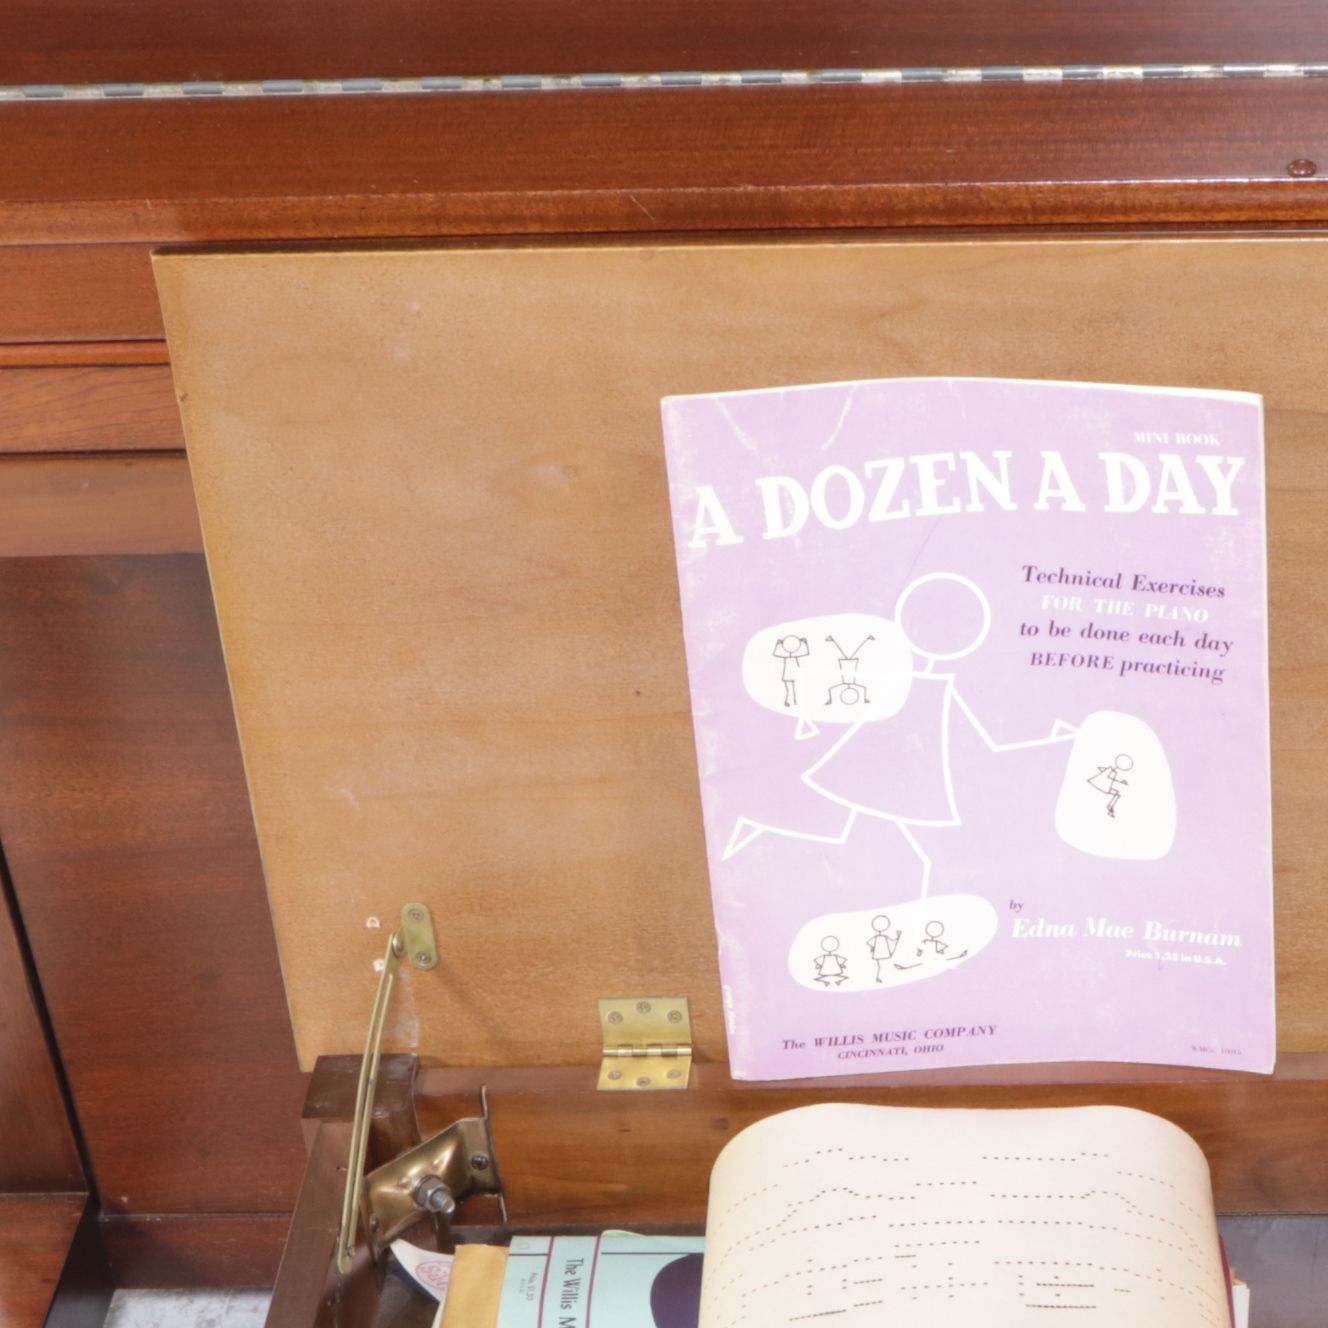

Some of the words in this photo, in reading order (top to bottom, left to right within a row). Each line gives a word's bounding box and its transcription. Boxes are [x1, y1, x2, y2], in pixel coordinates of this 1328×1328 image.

[1133, 431, 1169, 445] MINI
[1175, 432, 1221, 447] BOOK
[688, 485, 744, 548] A
[755, 450, 1017, 540] DOZEN
[1034, 450, 1086, 512] A
[1098, 451, 1246, 516] DAY
[1022, 565, 1123, 590] Technical
[1132, 574, 1226, 599] Exercises
[1041, 594, 1083, 612] FOR
[1094, 598, 1134, 617] THE
[1144, 603, 1209, 623] PIANO
[1019, 621, 1040, 637] to
[1048, 619, 1072, 638] be
[1080, 622, 1130, 642] done
[1138, 630, 1186, 648] each
[1194, 632, 1234, 658] day
[1029, 651, 1115, 670] BEFORE
[1119, 659, 1226, 686] practicing
[1009, 899, 1024, 913] by
[1011, 917, 1075, 939] Edna
[1083, 917, 1134, 939] Mae
[1144, 920, 1242, 947] Burnam
[1125, 949, 1152, 959] Price
[782, 1039, 806, 1050] The
[814, 1034, 864, 1048] WILLIS
[872, 1030, 917, 1044] MUSIC
[924, 1024, 998, 1040] COMPANY
[837, 1046, 908, 1060] CINCINNATI,
[914, 1044, 944, 1054] OHIO
[565, 1258, 584, 1276] The
[560, 1278, 582, 1310] Willis
